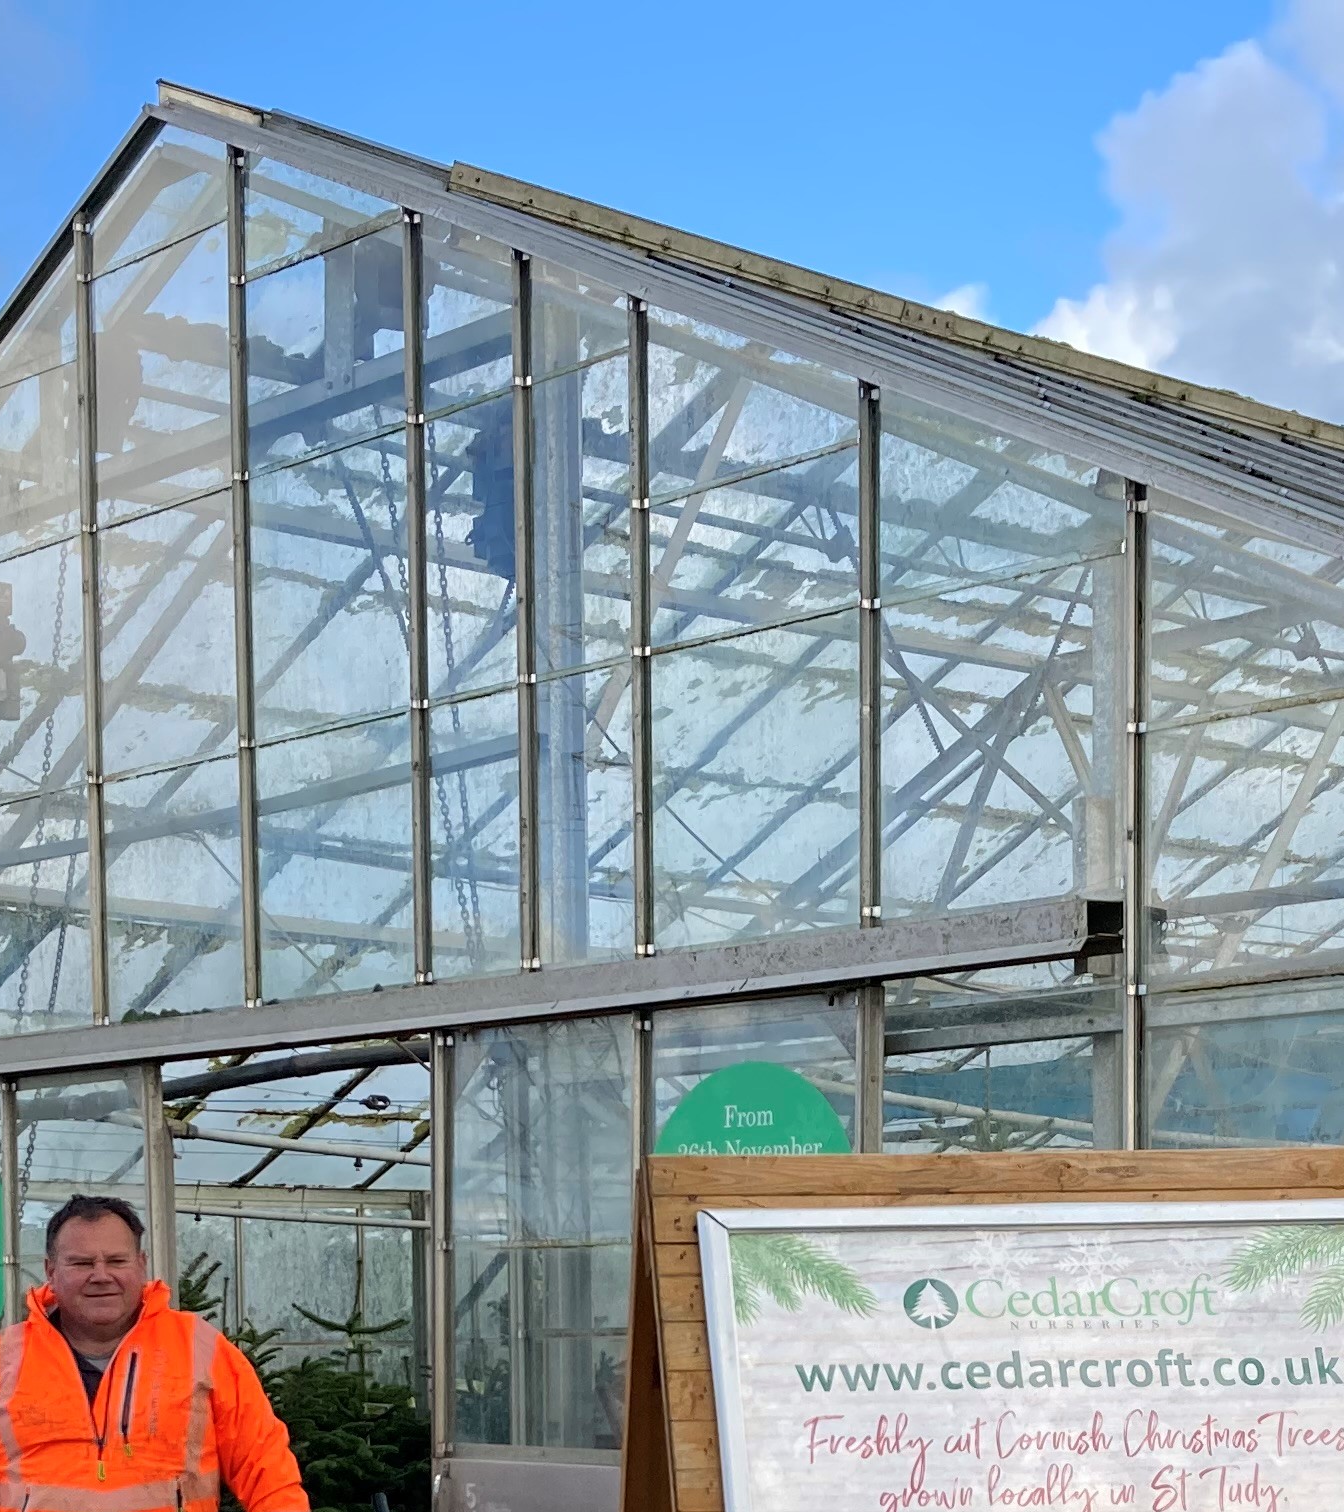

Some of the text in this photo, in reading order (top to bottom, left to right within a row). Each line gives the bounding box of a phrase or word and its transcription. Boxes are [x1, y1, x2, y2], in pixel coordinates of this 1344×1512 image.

[724, 1105, 774, 1128] From
[965, 1275, 1219, 1325] CedarCroft
[1010, 1320, 1161, 1330] NURSERIES
[795, 1347, 1344, 1393] www.cedarcroft.co.uk
[803, 1413, 935, 1492] Freshly
[943, 1417, 987, 1459] cut
[995, 1410, 1113, 1460] Cornish
[1123, 1408, 1260, 1459] Christmas
[1109, 1483, 1135, 1505] in
[1150, 1464, 1191, 1512] St
